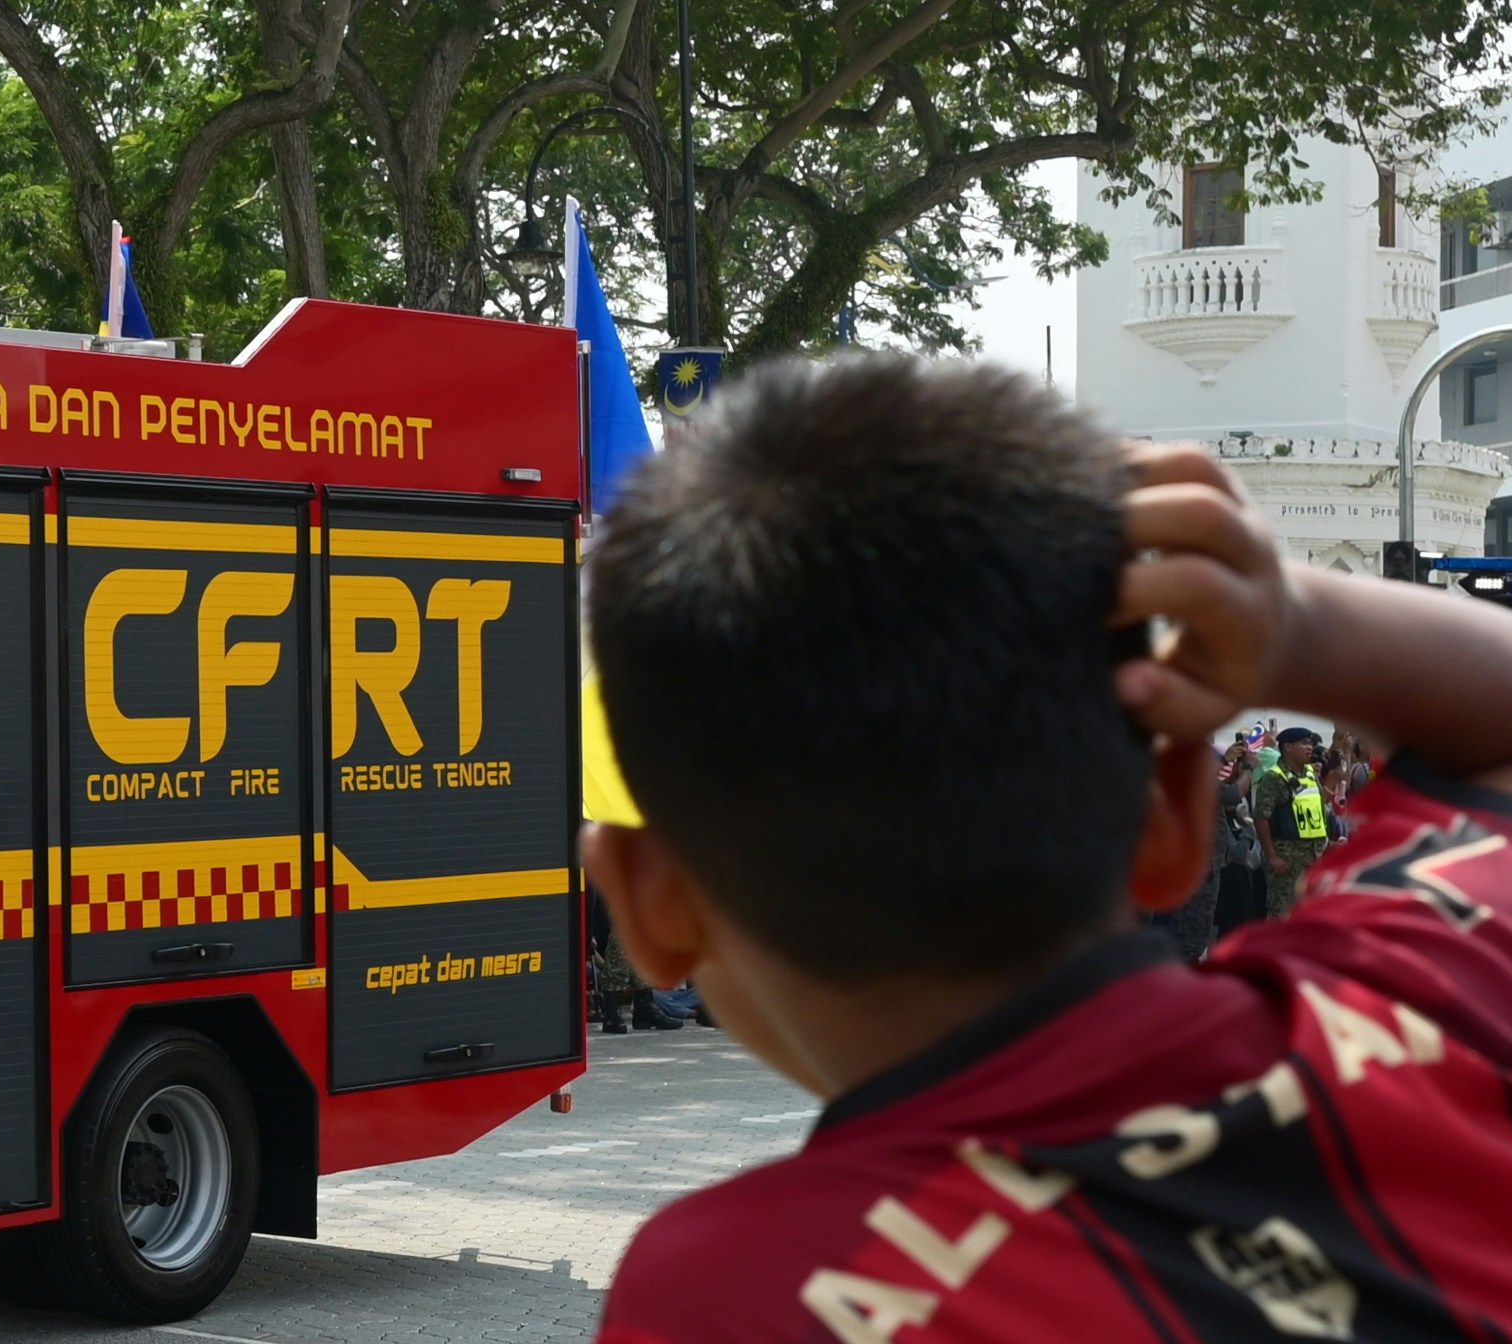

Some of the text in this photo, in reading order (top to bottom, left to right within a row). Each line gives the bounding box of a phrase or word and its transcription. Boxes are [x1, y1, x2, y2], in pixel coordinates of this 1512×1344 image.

[29, 384, 121, 439] DAN
[140, 395, 433, 460] PENYELAMAT
[84, 568, 512, 764] CFRT
[86, 761, 512, 802] COMPACT FIRE RESCUE TENDER
[366, 952, 542, 995] cepat dan mesra
